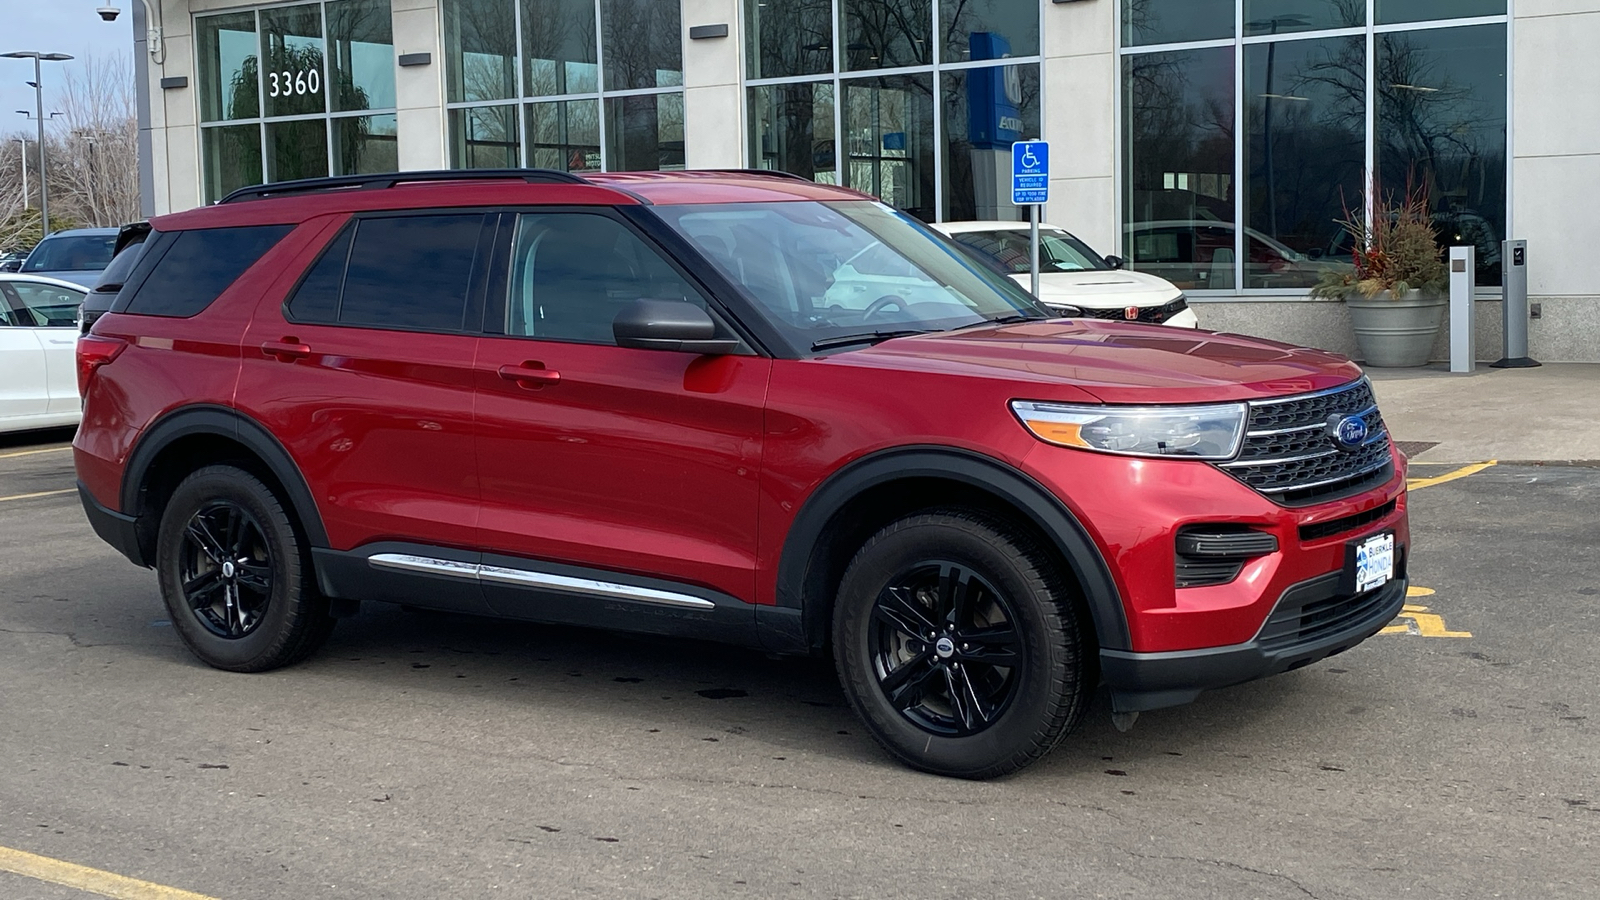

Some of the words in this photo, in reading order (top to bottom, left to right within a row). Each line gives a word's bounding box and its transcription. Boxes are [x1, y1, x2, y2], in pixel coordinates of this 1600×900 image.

[269, 69, 320, 97] 3360
[1346, 422, 1363, 440] Ford
[1368, 541, 1393, 558] BUERKLE
[1368, 554, 1391, 576] HONDA
